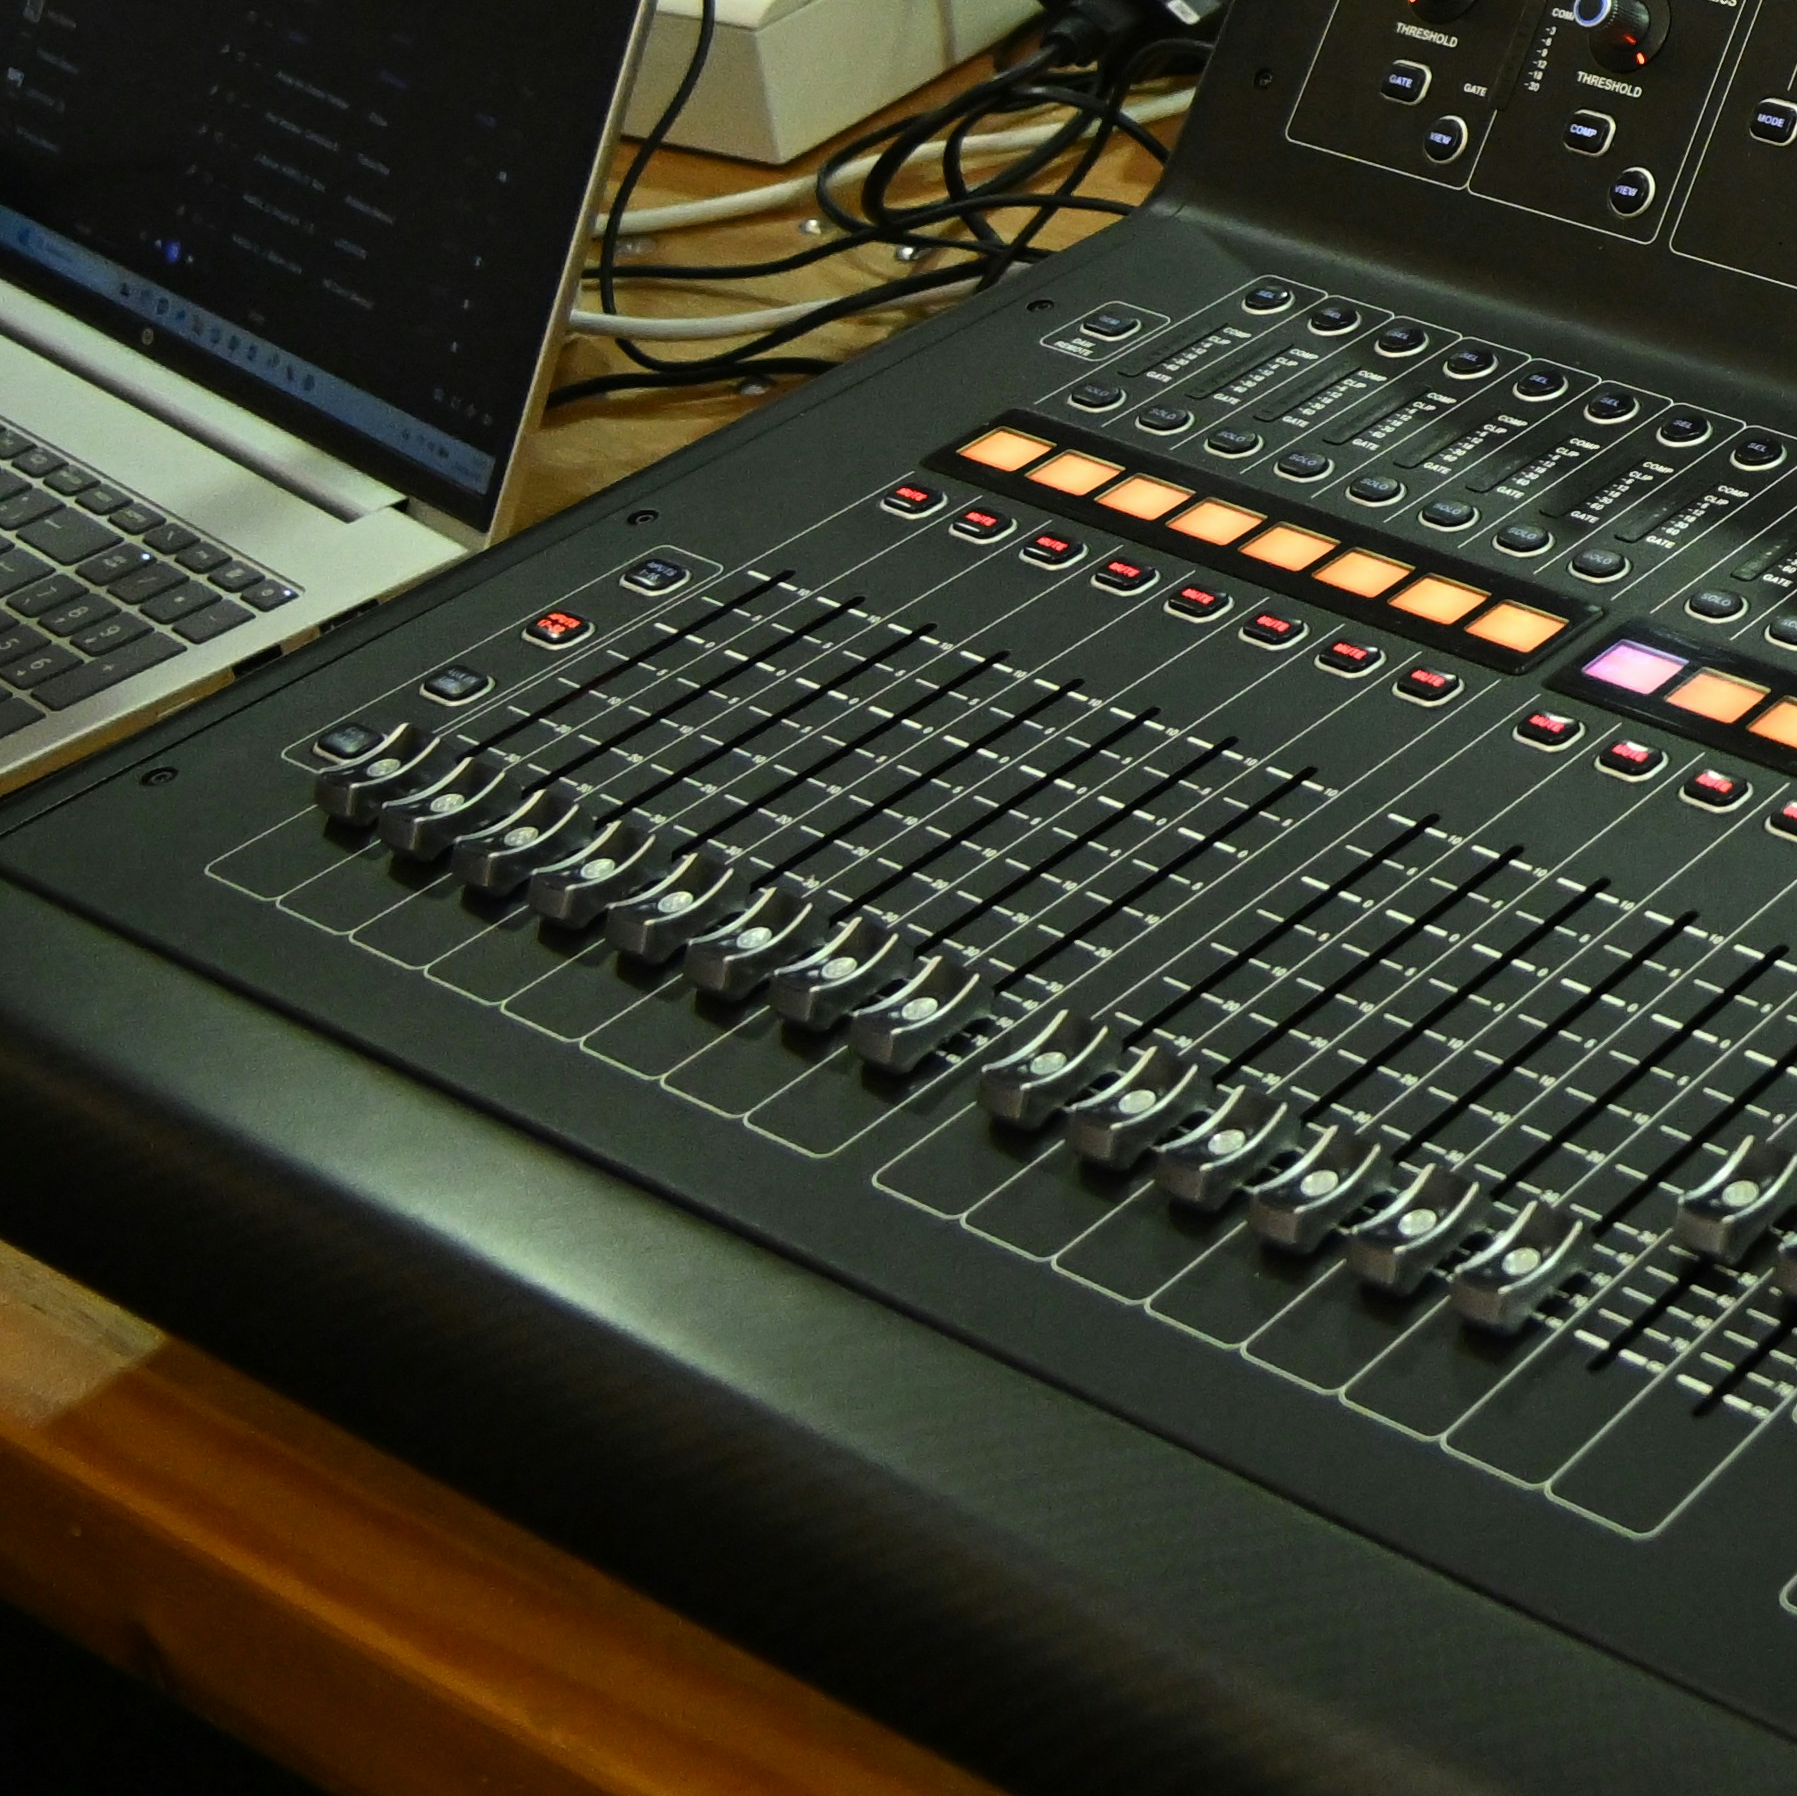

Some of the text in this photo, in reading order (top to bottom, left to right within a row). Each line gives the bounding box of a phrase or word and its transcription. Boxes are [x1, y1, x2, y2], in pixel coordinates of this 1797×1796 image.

[1551, 7, 1575, 20] COM
[1396, 21, 1458, 48] THRESHOLD
[1389, 74, 1413, 88] GATE
[1577, 70, 1643, 98] THRESHOLD
[1463, 82, 1488, 97] GATE
[1757, 113, 1785, 128] MODE
[1570, 123, 1598, 138] COMP
[1429, 132, 1452, 145] VIEW
[1614, 185, 1638, 197] VIEW
